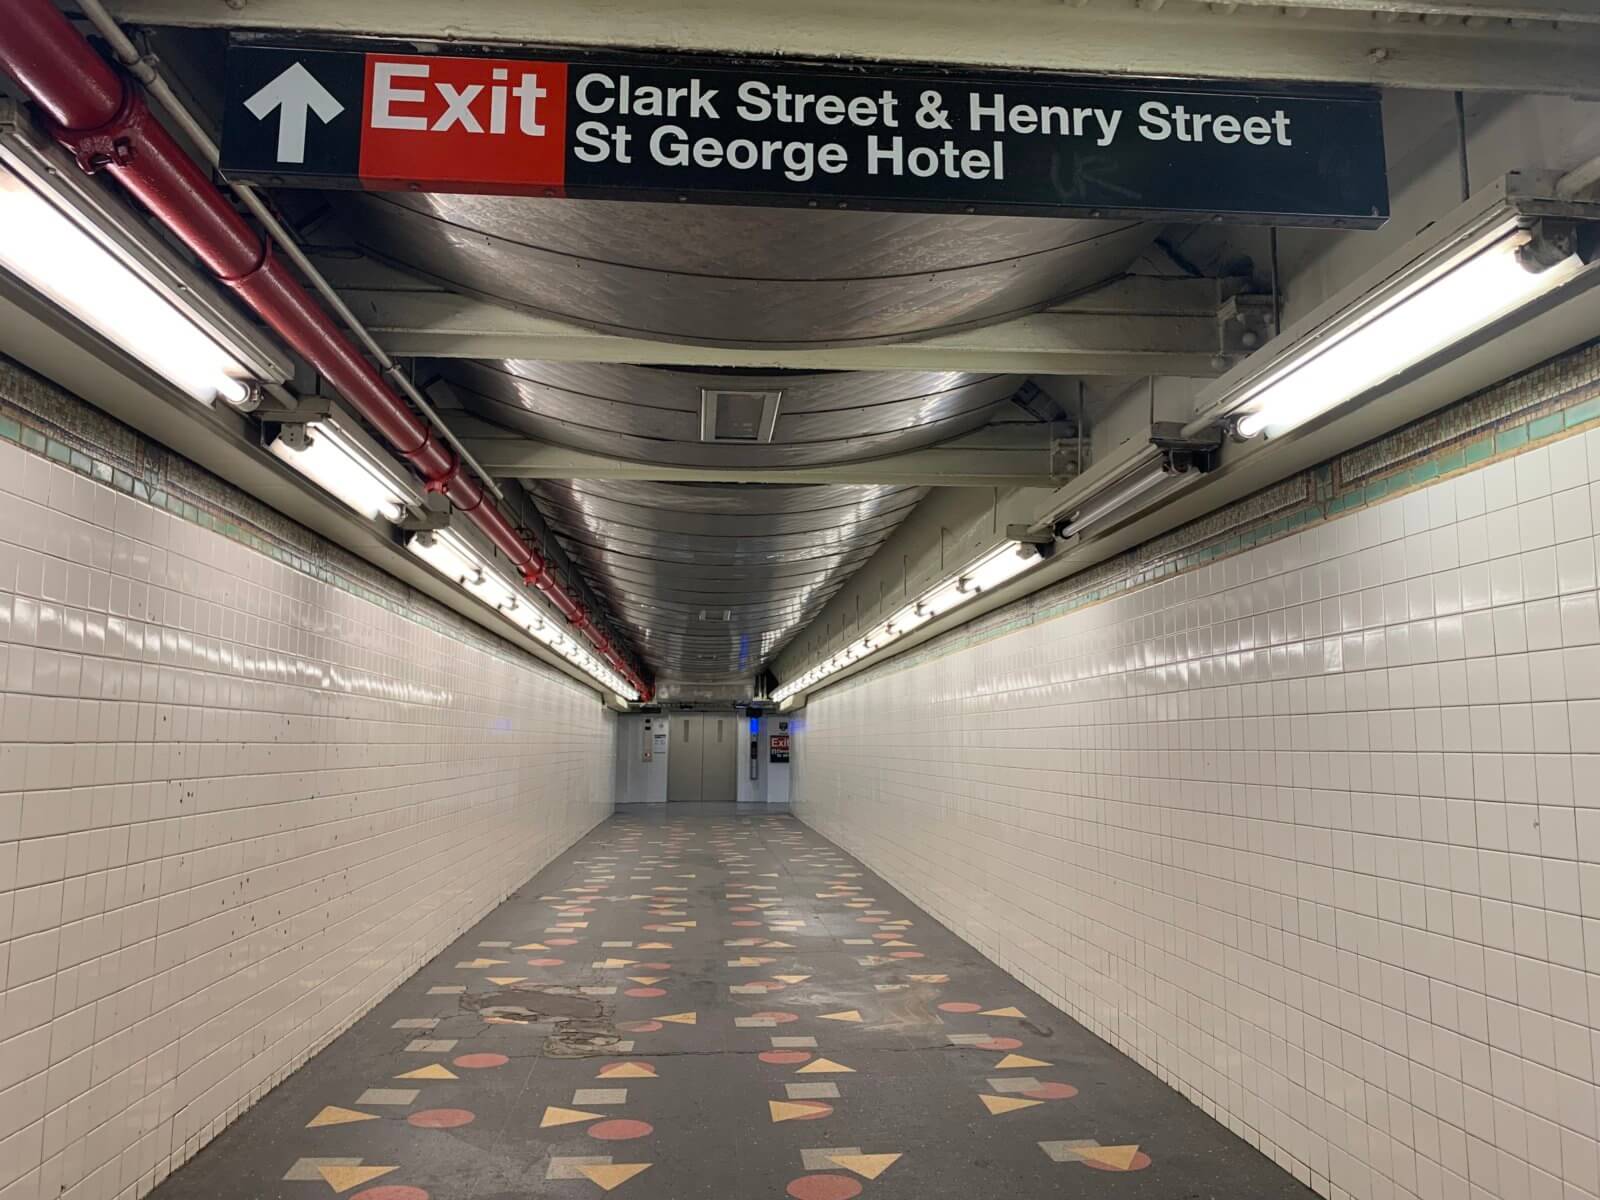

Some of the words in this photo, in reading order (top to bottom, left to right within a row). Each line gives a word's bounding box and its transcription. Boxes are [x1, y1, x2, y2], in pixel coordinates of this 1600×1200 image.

[370, 62, 547, 137] Exit
[575, 73, 720, 117] Clark
[736, 80, 899, 128] Street
[915, 90, 953, 130] &
[969, 92, 1123, 147] Henry
[1138, 101, 1292, 146] Street
[573, 121, 632, 164] St
[649, 124, 848, 182] George
[867, 135, 1004, 180] Hotel
